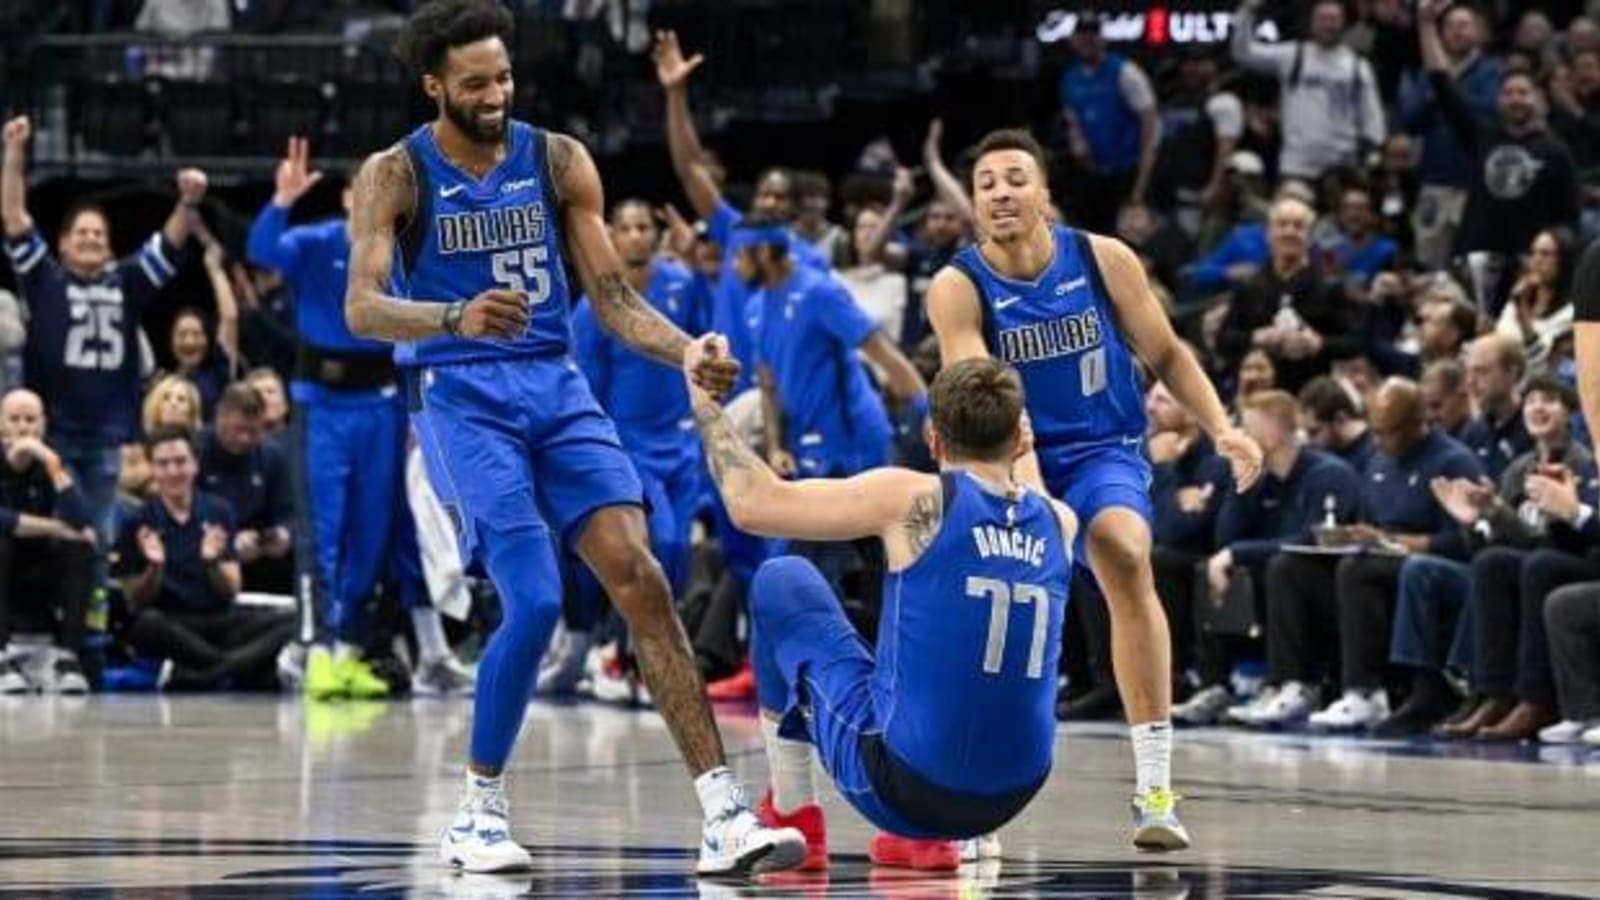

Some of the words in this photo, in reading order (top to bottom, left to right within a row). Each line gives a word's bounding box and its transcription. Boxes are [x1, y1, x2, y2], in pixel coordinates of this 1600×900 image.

[436, 202, 545, 254] DALLAS
[491, 245, 551, 305] 55
[64, 303, 124, 369] 25
[999, 307, 1102, 363] DALLAS
[1080, 346, 1107, 397] 0
[965, 575, 1050, 679] 77
